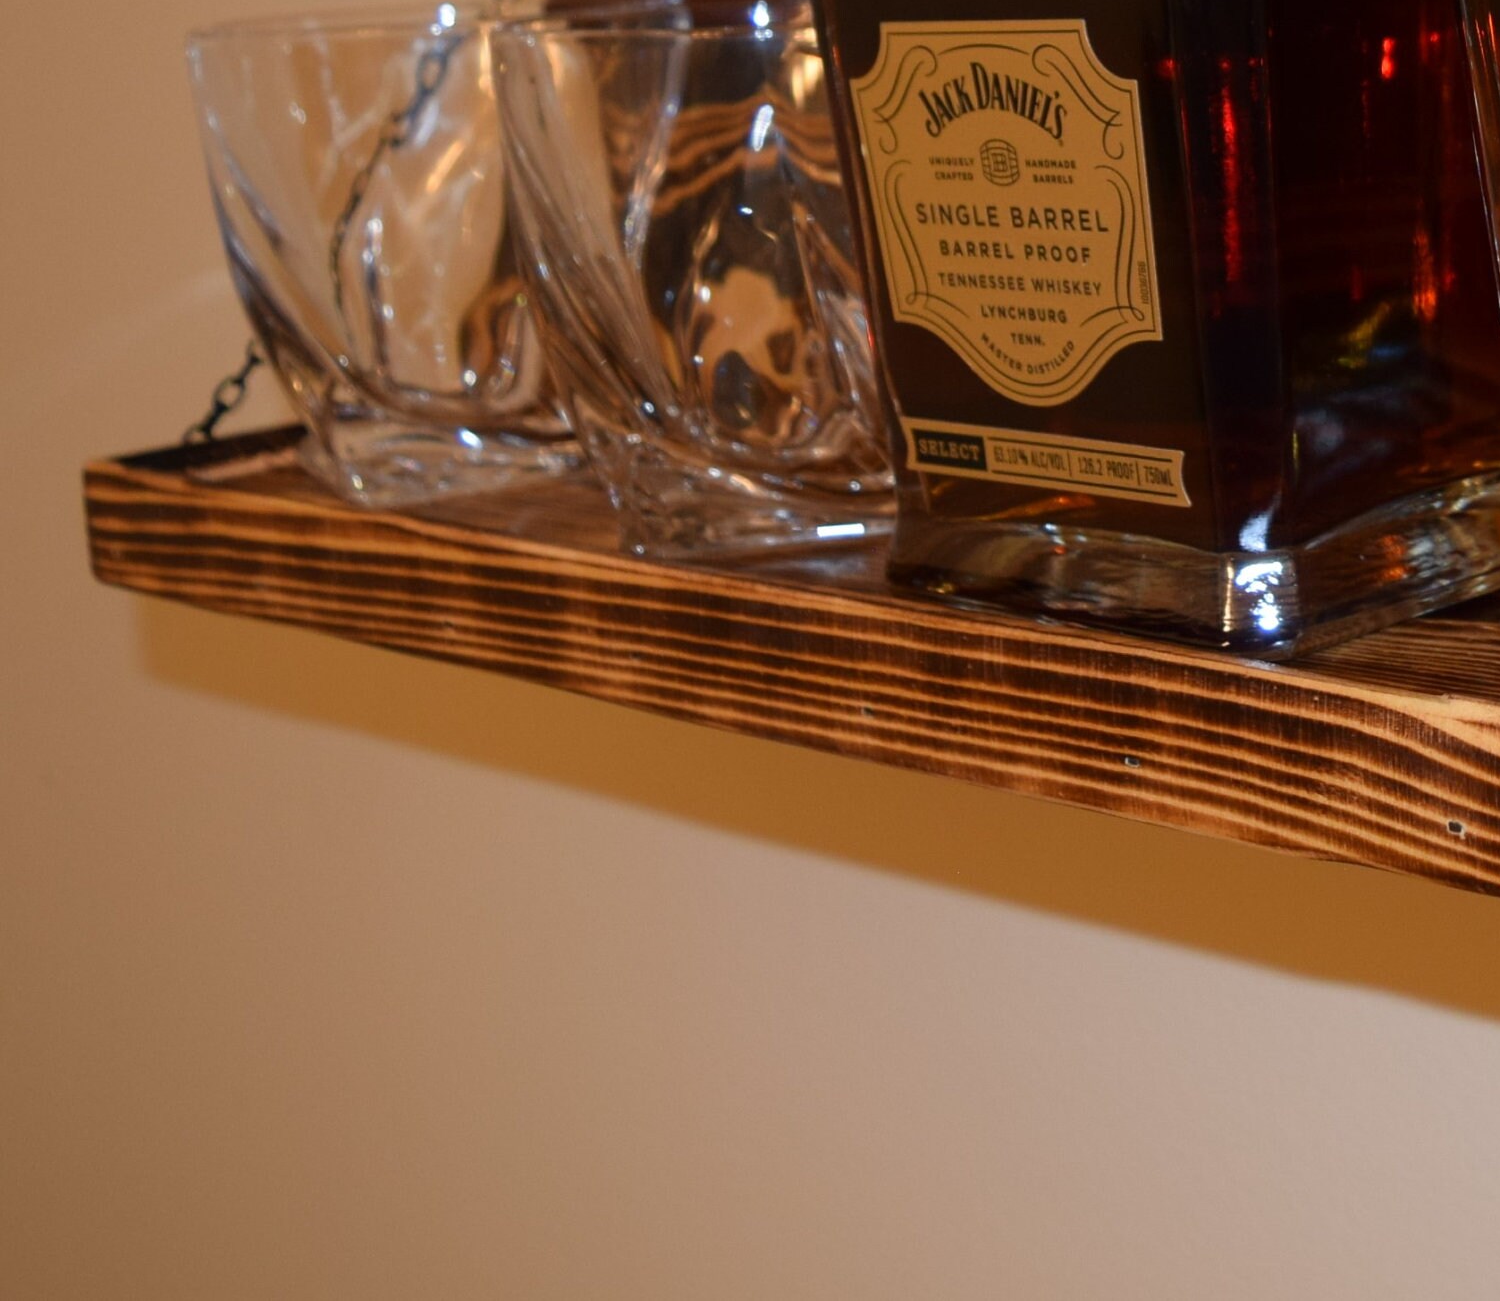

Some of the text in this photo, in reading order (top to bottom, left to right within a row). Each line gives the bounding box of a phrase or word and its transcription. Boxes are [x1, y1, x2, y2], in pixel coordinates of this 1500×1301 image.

[918, 76, 975, 138] JACK
[929, 157, 975, 166] UNIQUELY
[1025, 160, 1076, 170] HANDMADE
[935, 172, 974, 181] CRAFTED
[1033, 174, 1074, 185] BARRELS
[915, 203, 1109, 232] SINGLE BARREL
[939, 240, 1091, 263] BARREL PROOF
[938, 272, 1101, 296] TENNESSEE WHISKEY
[981, 305, 1068, 324] LYNCHBURG
[1010, 333, 1046, 346] TENN.
[981, 333, 1075, 375] MASTER DISTILLED
[918, 437, 979, 462] SELECT
[1078, 457, 1103, 476] 126.2
[1106, 461, 1136, 481] PROOF
